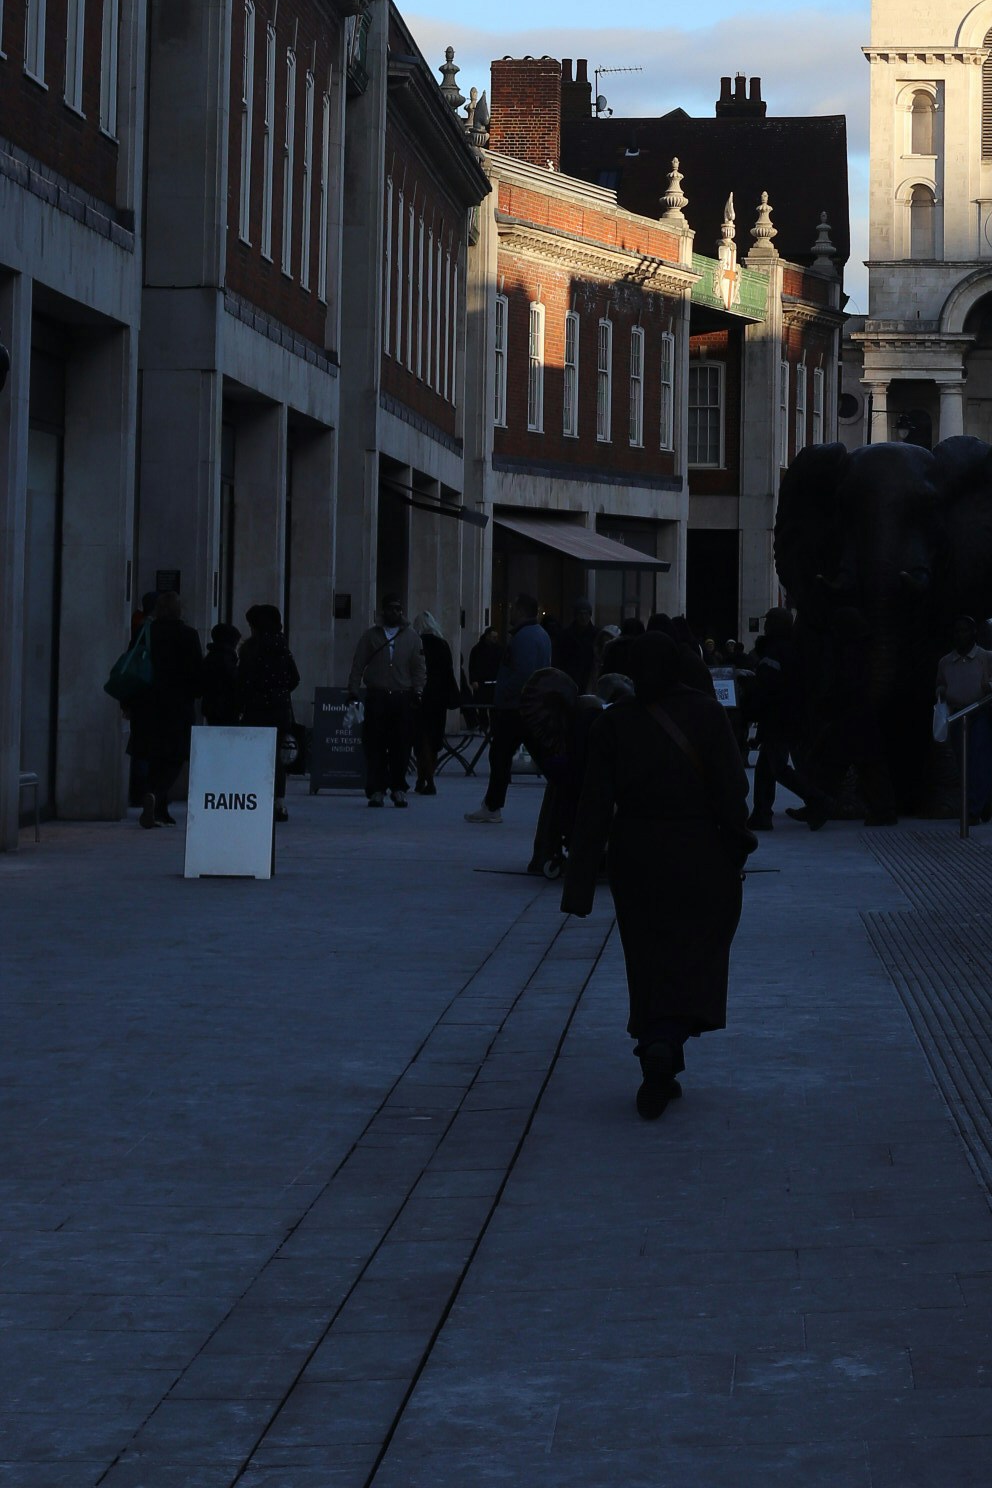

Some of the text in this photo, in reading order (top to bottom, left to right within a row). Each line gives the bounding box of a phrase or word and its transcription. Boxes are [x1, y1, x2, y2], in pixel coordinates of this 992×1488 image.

[322, 703, 351, 712] bloob
[331, 745, 355, 753] INSIDE
[204, 793, 257, 811] RAINS
